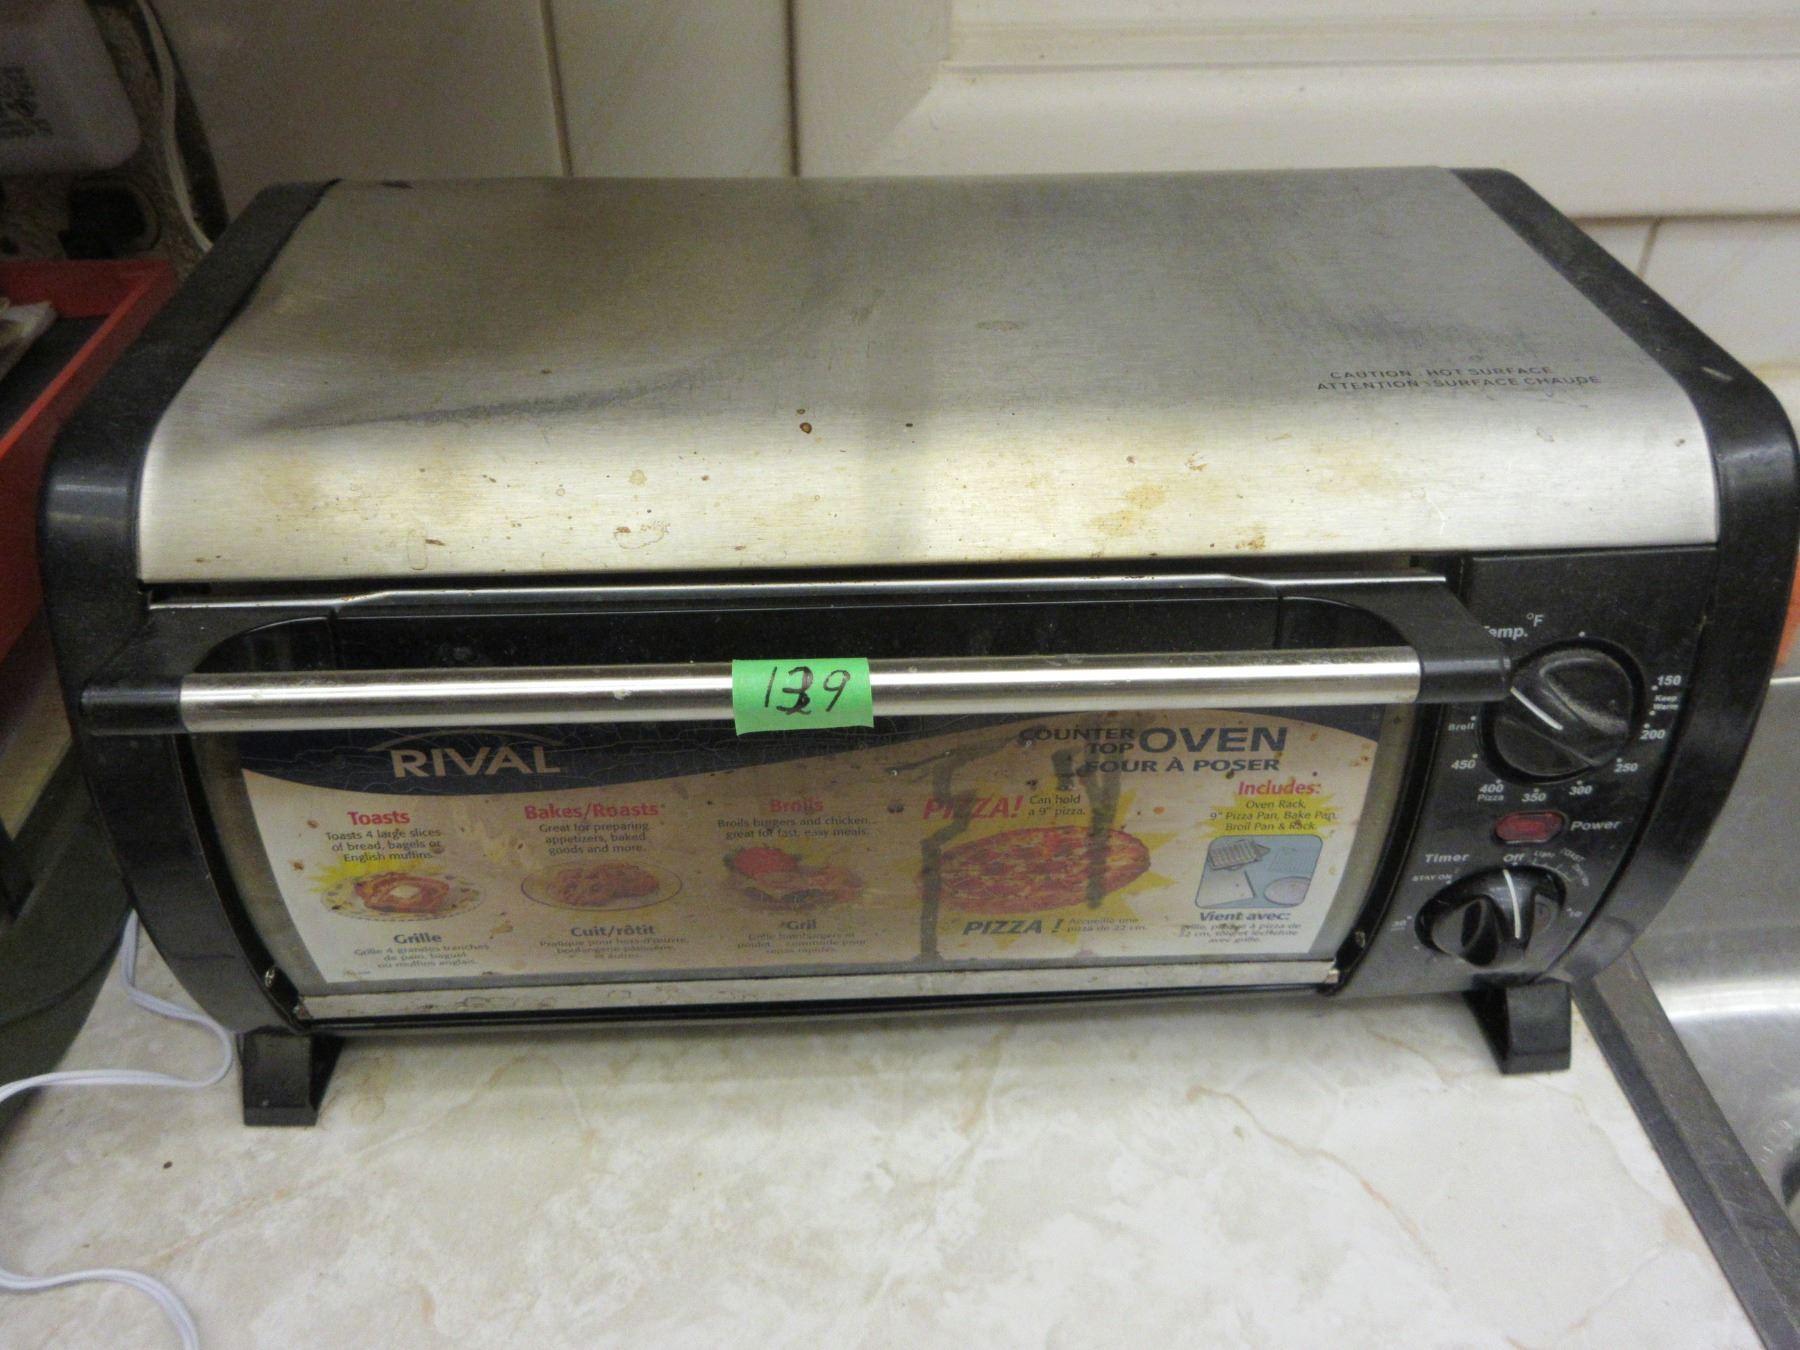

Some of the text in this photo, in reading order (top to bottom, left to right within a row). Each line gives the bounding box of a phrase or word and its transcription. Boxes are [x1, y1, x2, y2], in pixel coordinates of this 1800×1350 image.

[1426, 367, 1462, 377] HOT
[1469, 367, 1553, 376] SURFACE
[1433, 378, 1518, 387] SURFACE
[1524, 376, 1601, 386] CHAUDE
[1484, 625, 1528, 640] emp.
[1657, 675, 1682, 686] 150
[1448, 723, 1474, 731] Broil
[1019, 728, 1135, 741] COUNTER
[1139, 726, 1288, 753] OVEN
[1640, 729, 1666, 740] 200
[1086, 742, 1134, 754] TOP
[391, 745, 560, 778] RIVAL
[1086, 756, 1280, 773] FOUR À POSER
[1451, 760, 1476, 770] 450
[1614, 763, 1638, 773] 250
[1238, 778, 1321, 796] Includes:
[1479, 784, 1504, 793] 400
[1569, 785, 1593, 795] 300
[1029, 794, 1080, 805] Can hold
[1521, 793, 1547, 802] 350
[769, 798, 825, 813] Broils
[922, 795, 1024, 819] PIZZA!
[1245, 800, 1275, 809] Oven
[524, 803, 659, 820] Bakes/Roasts
[1028, 808, 1035, 816] a
[1054, 807, 1086, 817] pizza.
[1225, 811, 1253, 820] Pizza
[1256, 811, 1280, 821] Pan,
[1283, 810, 1311, 819] Bake
[347, 811, 410, 825] Toasts
[717, 818, 750, 828] Broils
[753, 817, 795, 829] burgers
[800, 816, 821, 826] and
[539, 822, 649, 833] Great for preparing
[1225, 822, 1251, 831] Broil
[1254, 822, 1275, 831] Pan
[1278, 822, 1286, 830] &
[1570, 819, 1621, 832] Power
[325, 832, 362, 841] Toasts
[377, 829, 406, 840] large
[410, 828, 441, 837] slices
[546, 832, 646, 845] appetizers, baked
[726, 829, 754, 840] great
[758, 828, 773, 838] for
[332, 842, 343, 852] of
[346, 841, 385, 851] bread,
[388, 840, 426, 851] bagels
[548, 845, 583, 856] goods
[587, 844, 608, 853] and
[344, 853, 385, 863] English
[1425, 853, 1470, 863] Timer
[1503, 853, 1526, 862] Off
[1200, 911, 1291, 921] Vient avec:
[786, 919, 816, 930] Gril
[962, 918, 1063, 935] PIZZA !
[570, 924, 656, 938] Cuit/rôtit
[393, 932, 442, 944] Grille
